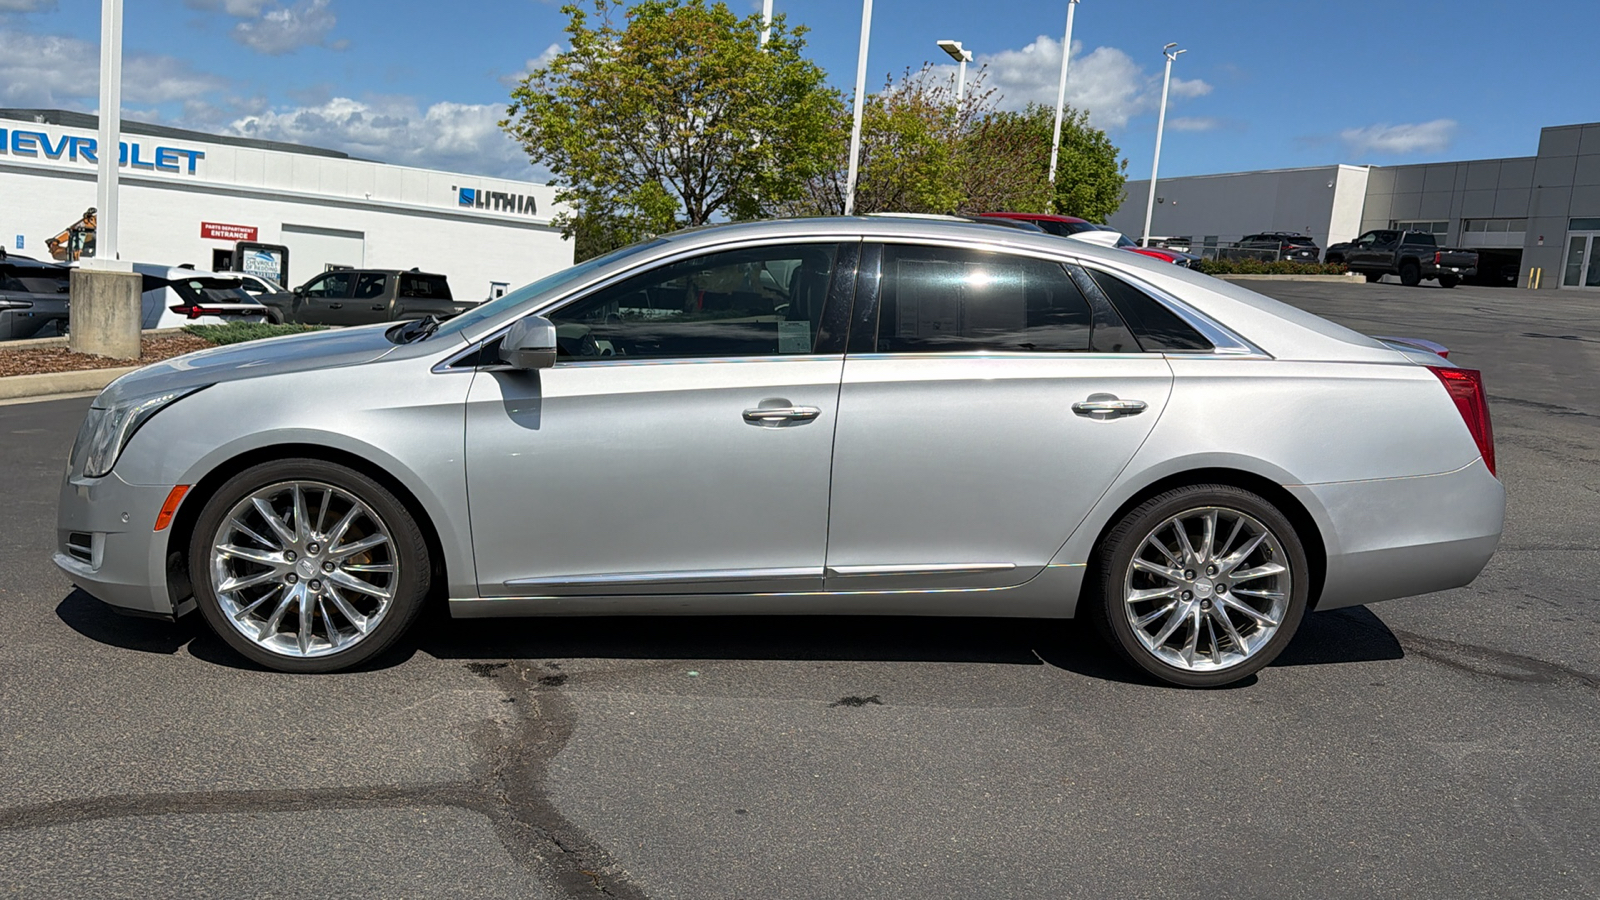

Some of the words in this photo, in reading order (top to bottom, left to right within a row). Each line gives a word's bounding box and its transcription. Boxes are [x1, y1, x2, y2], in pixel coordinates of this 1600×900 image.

[475, 189, 537, 215] LITHIA
[222, 225, 254, 234] DEPARTMENT
[211, 230, 248, 239] ENTRANCE
